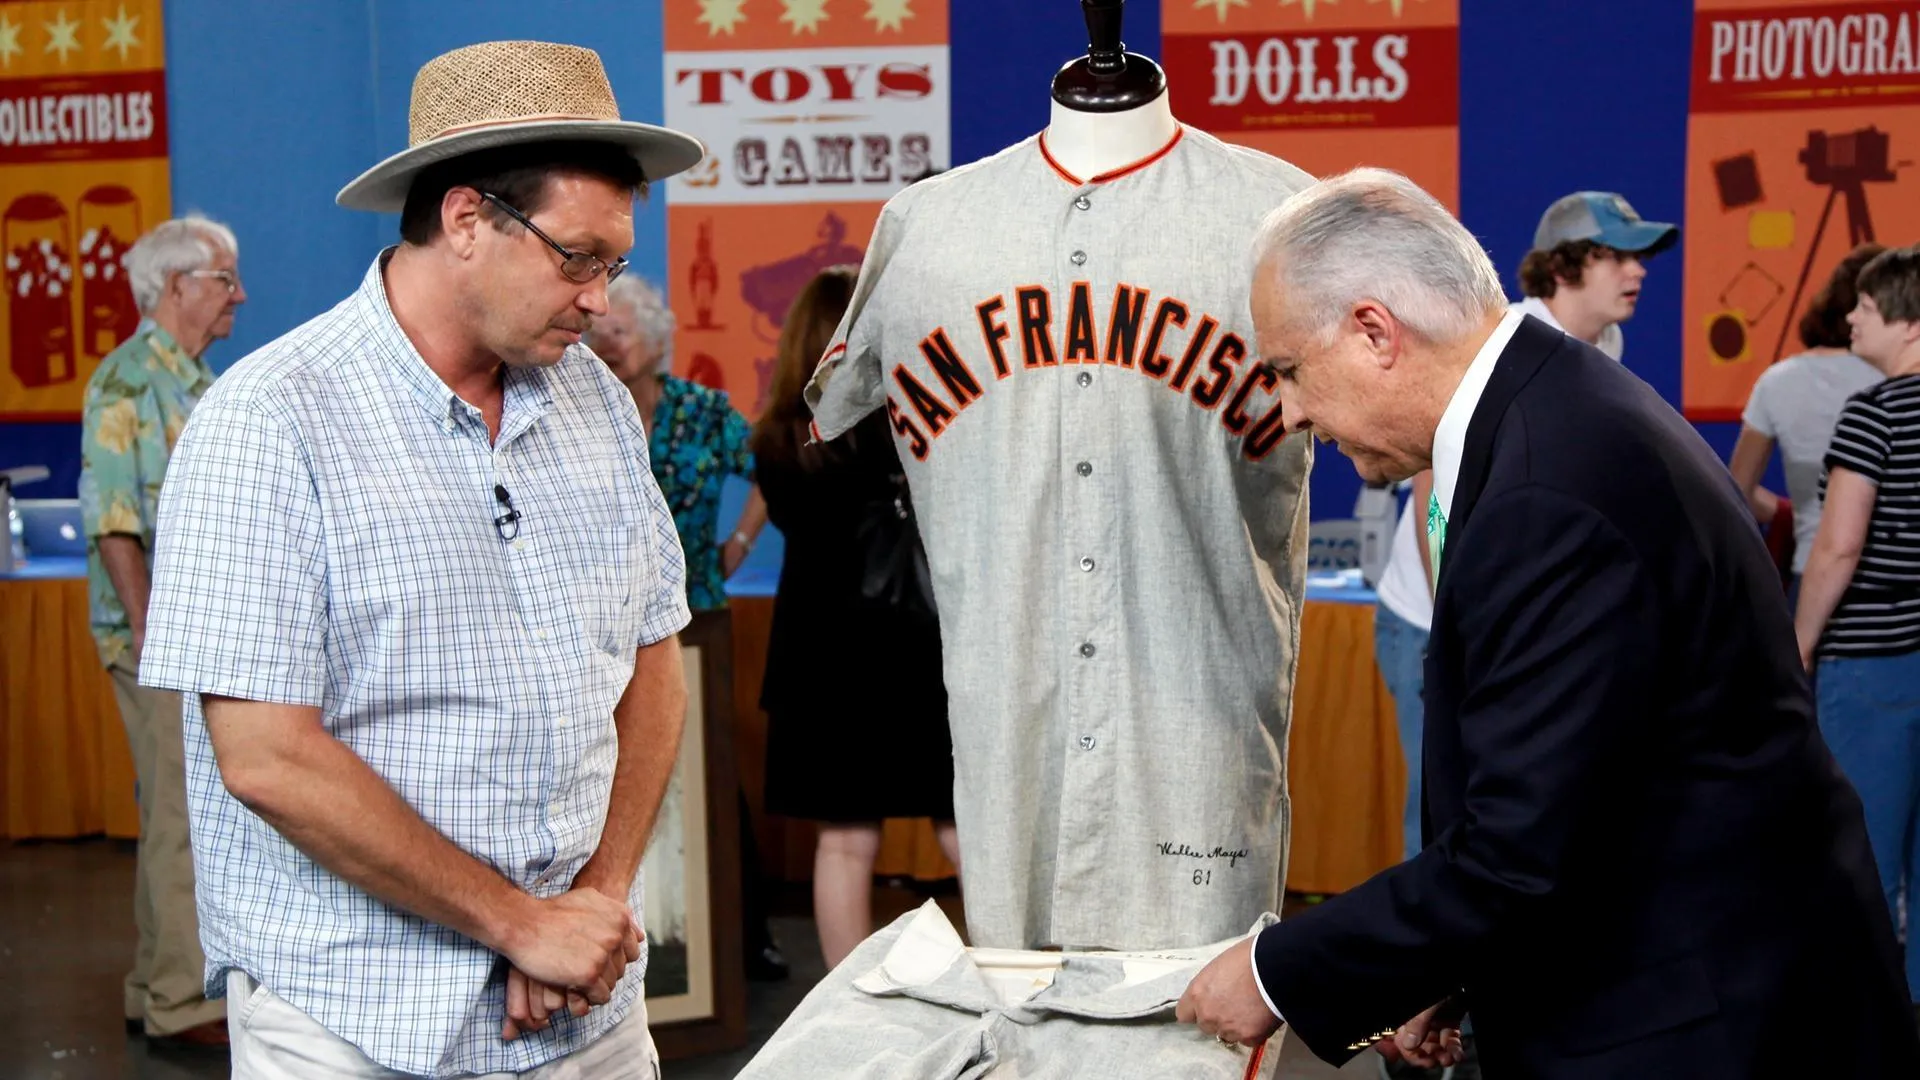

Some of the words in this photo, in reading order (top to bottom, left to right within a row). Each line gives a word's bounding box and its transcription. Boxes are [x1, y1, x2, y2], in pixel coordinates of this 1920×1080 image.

[1209, 34, 1409, 106] DOLLS
[1709, 11, 1920, 83] PHOTOGRA
[676, 63, 934, 107] TOYS
[0, 91, 154, 146] OLLECTIBLES
[735, 134, 932, 187] GAMES
[887, 327, 984, 462] SAN
[975, 281, 1288, 462] FRANCISCO
[1156, 842, 1204, 859] Willie
[1207, 846, 1249, 868] Mays
[1192, 869, 1211, 885] 61
